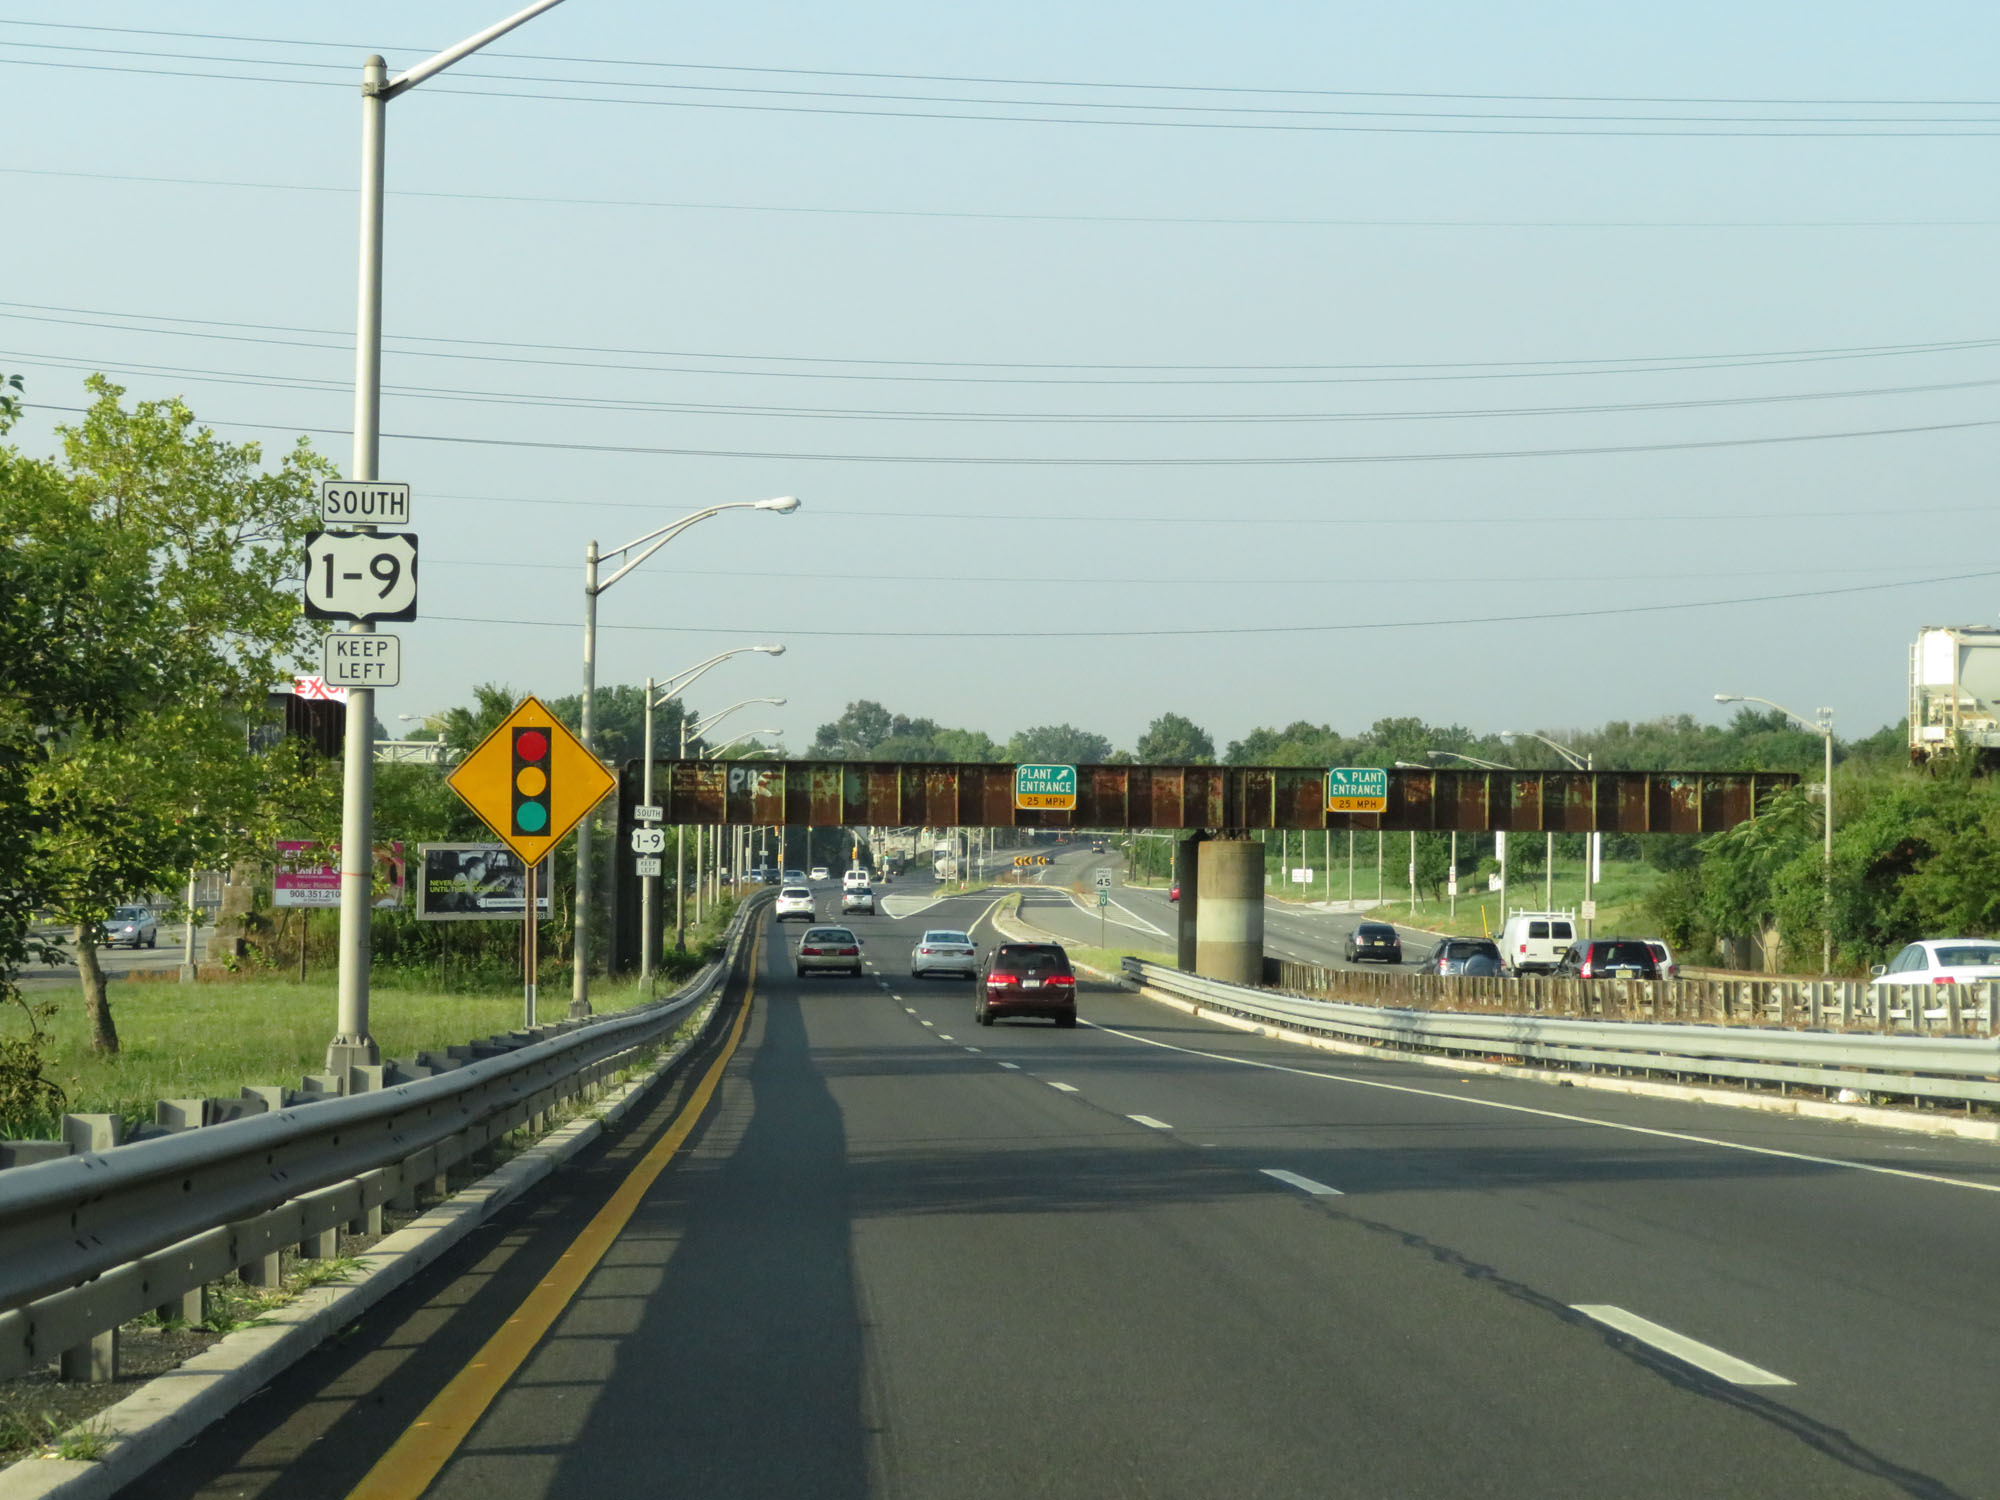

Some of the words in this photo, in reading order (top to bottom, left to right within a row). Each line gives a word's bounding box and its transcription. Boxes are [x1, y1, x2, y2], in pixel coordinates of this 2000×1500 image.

[327, 489, 404, 516] SOUTH
[322, 552, 401, 600] 1-9
[337, 640, 388, 657] KEEP
[339, 662, 385, 679] LEFT
[294, 677, 344, 700] EXX
[1021, 768, 1052, 780] PLANT
[1352, 771, 1383, 783] PLANT
[1020, 780, 1072, 793] ENTRANCE
[1333, 783, 1382, 796] ENTRANCE
[1027, 797, 1039, 806] 25
[1045, 797, 1066, 806] MPH
[1339, 799, 1351, 808] 25
[1357, 799, 1377, 808] MPH
[636, 808, 661, 818] SOUTH
[636, 833, 661, 849] 1-9
[1096, 878, 1111, 887] 45
